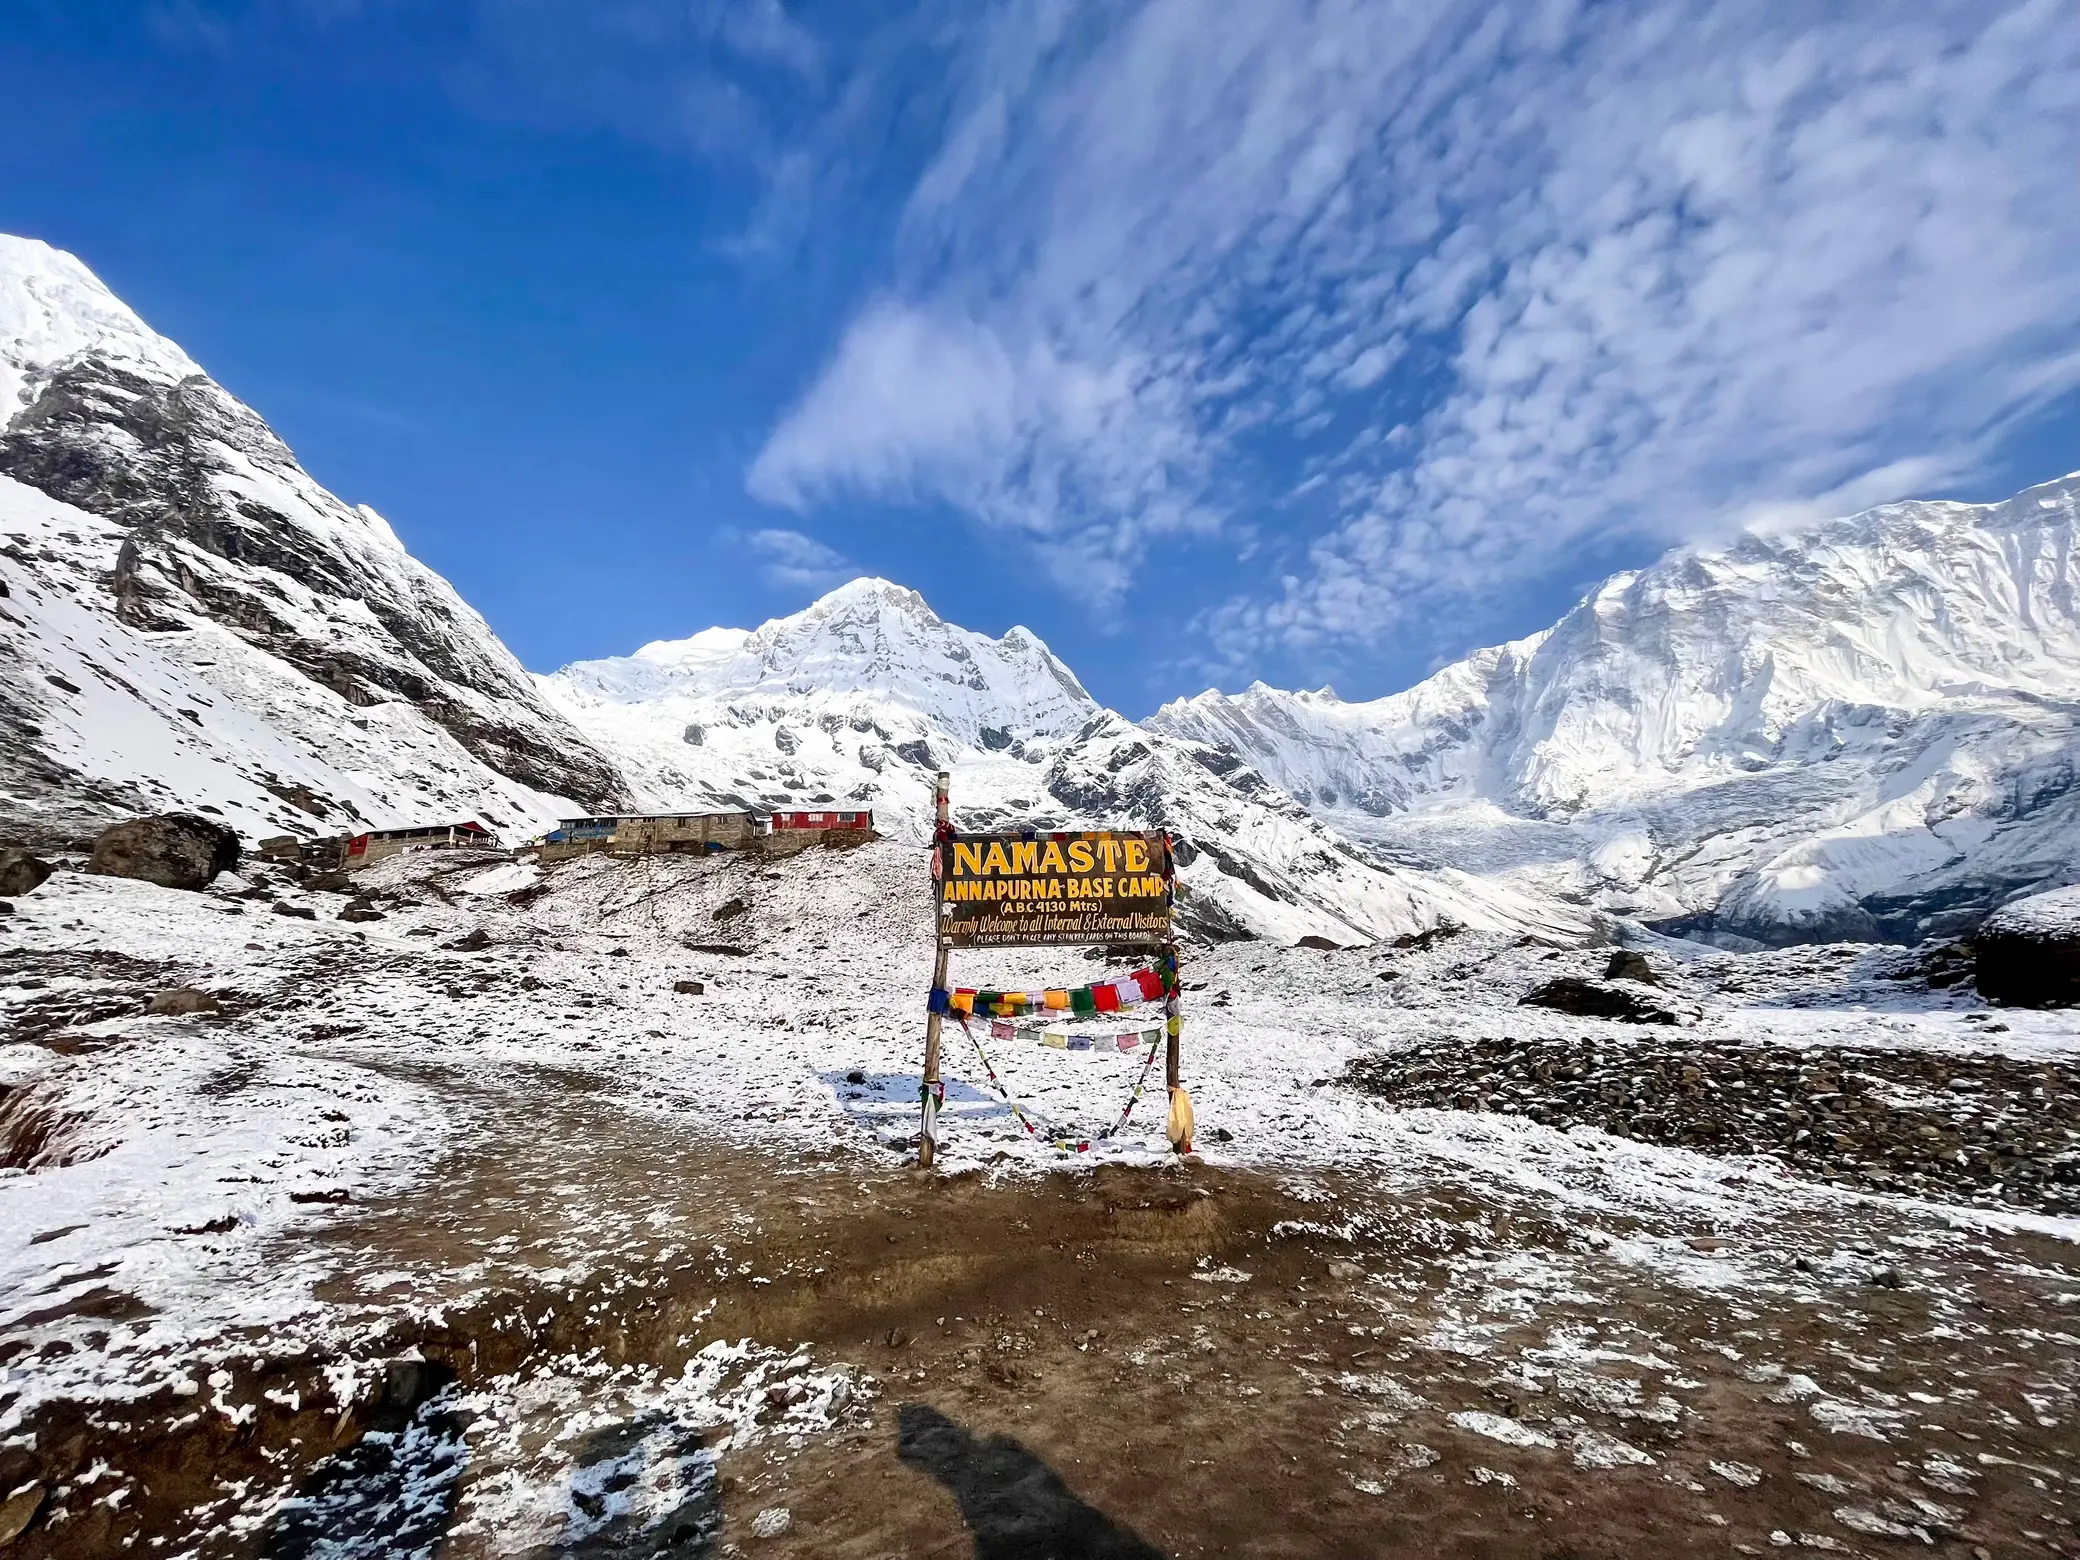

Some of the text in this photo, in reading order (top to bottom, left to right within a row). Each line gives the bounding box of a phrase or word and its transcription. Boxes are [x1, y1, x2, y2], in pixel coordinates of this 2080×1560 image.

[953, 839, 1150, 876] NAMASTE
[943, 876, 1164, 901] ANNAPURNA BASE CAMP
[1070, 900, 1103, 913] Mtrs)
[942, 916, 979, 938] Warmly
[980, 914, 1018, 934] Welcome
[1020, 915, 1029, 932] to
[1029, 914, 1044, 931] all
[1044, 914, 1083, 931] Internal
[1134, 912, 1168, 929] Visitors
